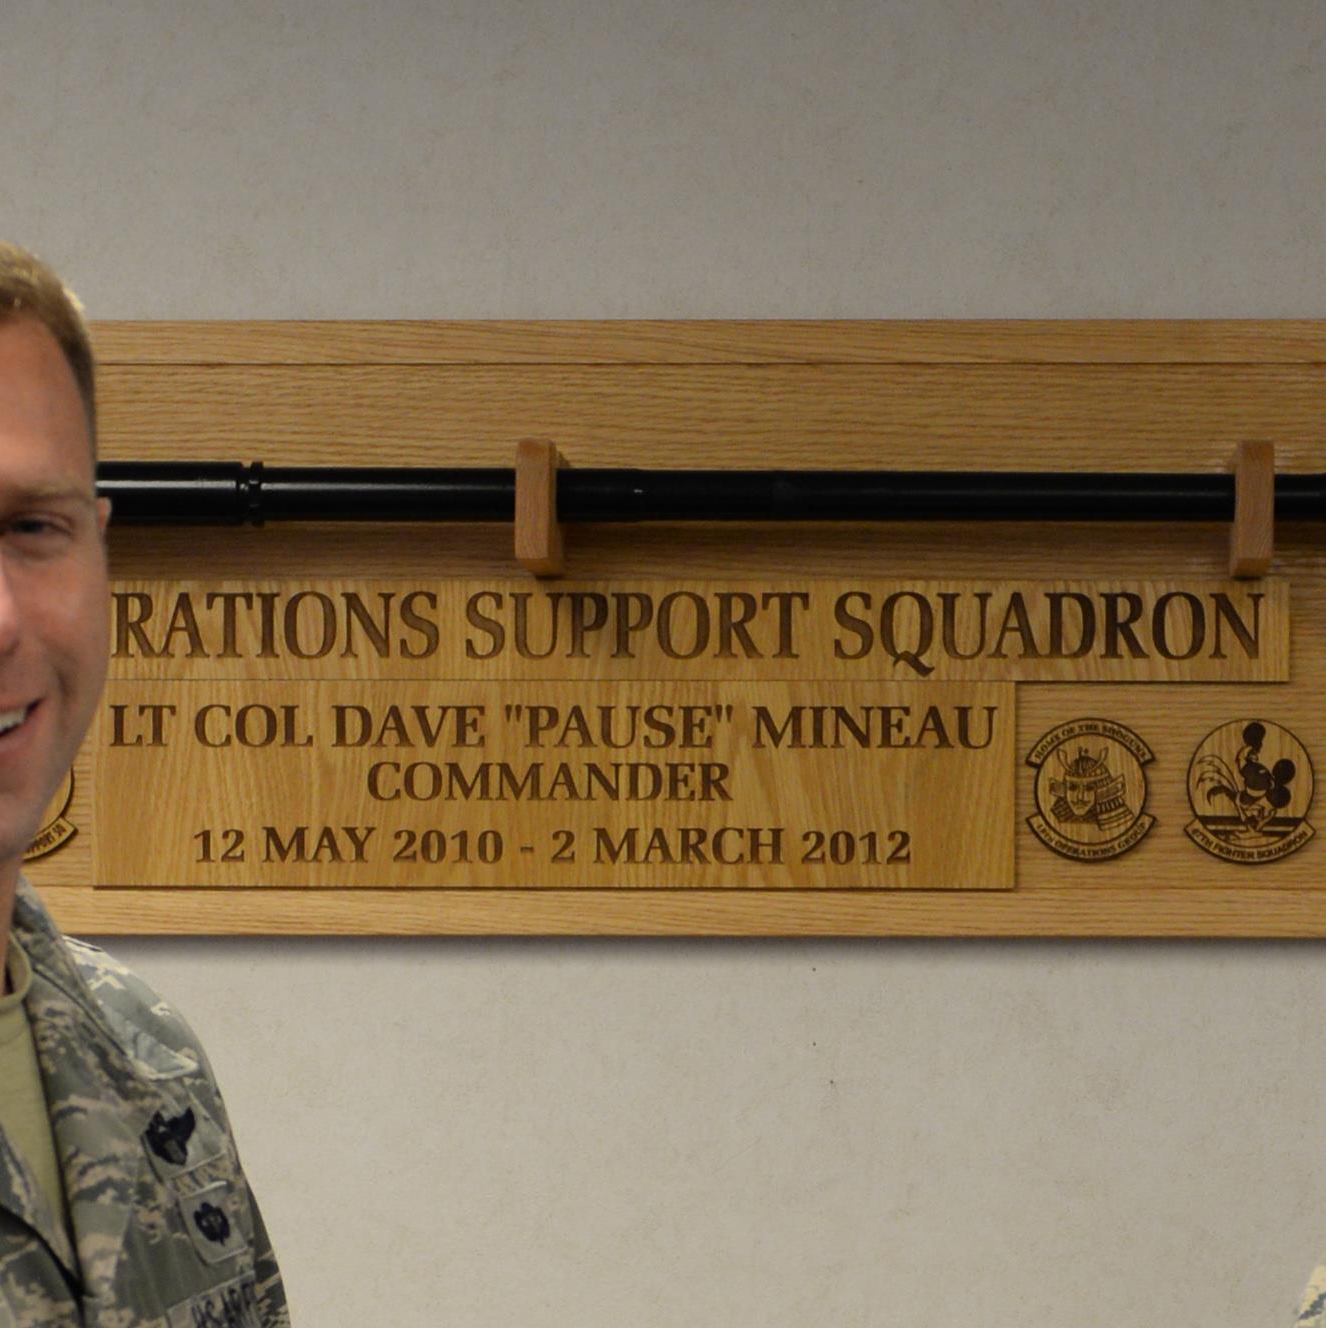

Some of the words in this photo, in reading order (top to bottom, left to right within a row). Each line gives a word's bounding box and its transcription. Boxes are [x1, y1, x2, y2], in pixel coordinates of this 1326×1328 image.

[111, 591, 440, 660] RATIONS
[465, 590, 810, 661] SUPPORT
[834, 590, 1264, 677] SQUADRON
[109, 705, 176, 748] LT
[194, 703, 313, 748] COL
[332, 705, 485, 748] DAVE
[505, 703, 734, 748] "PAUSE"
[752, 705, 998, 749] MINEAU
[1034, 734, 1061, 760] HOME
[1061, 725, 1076, 737] OF
[1078, 723, 1100, 732] THE
[367, 761, 733, 802] COMMANDER
[193, 829, 245, 863] 12
[262, 827, 376, 863] MAY
[393, 829, 505, 864] 2010
[550, 830, 576, 864] 2
[592, 827, 783, 865] MARCH
[801, 829, 912, 865] 2012
[1054, 840, 1117, 857] OPERATIONS
[1117, 822, 1147, 849] GROUP
[1213, 841, 1256, 861] FIGHTER
[1256, 830, 1307, 859] SQUADRON
